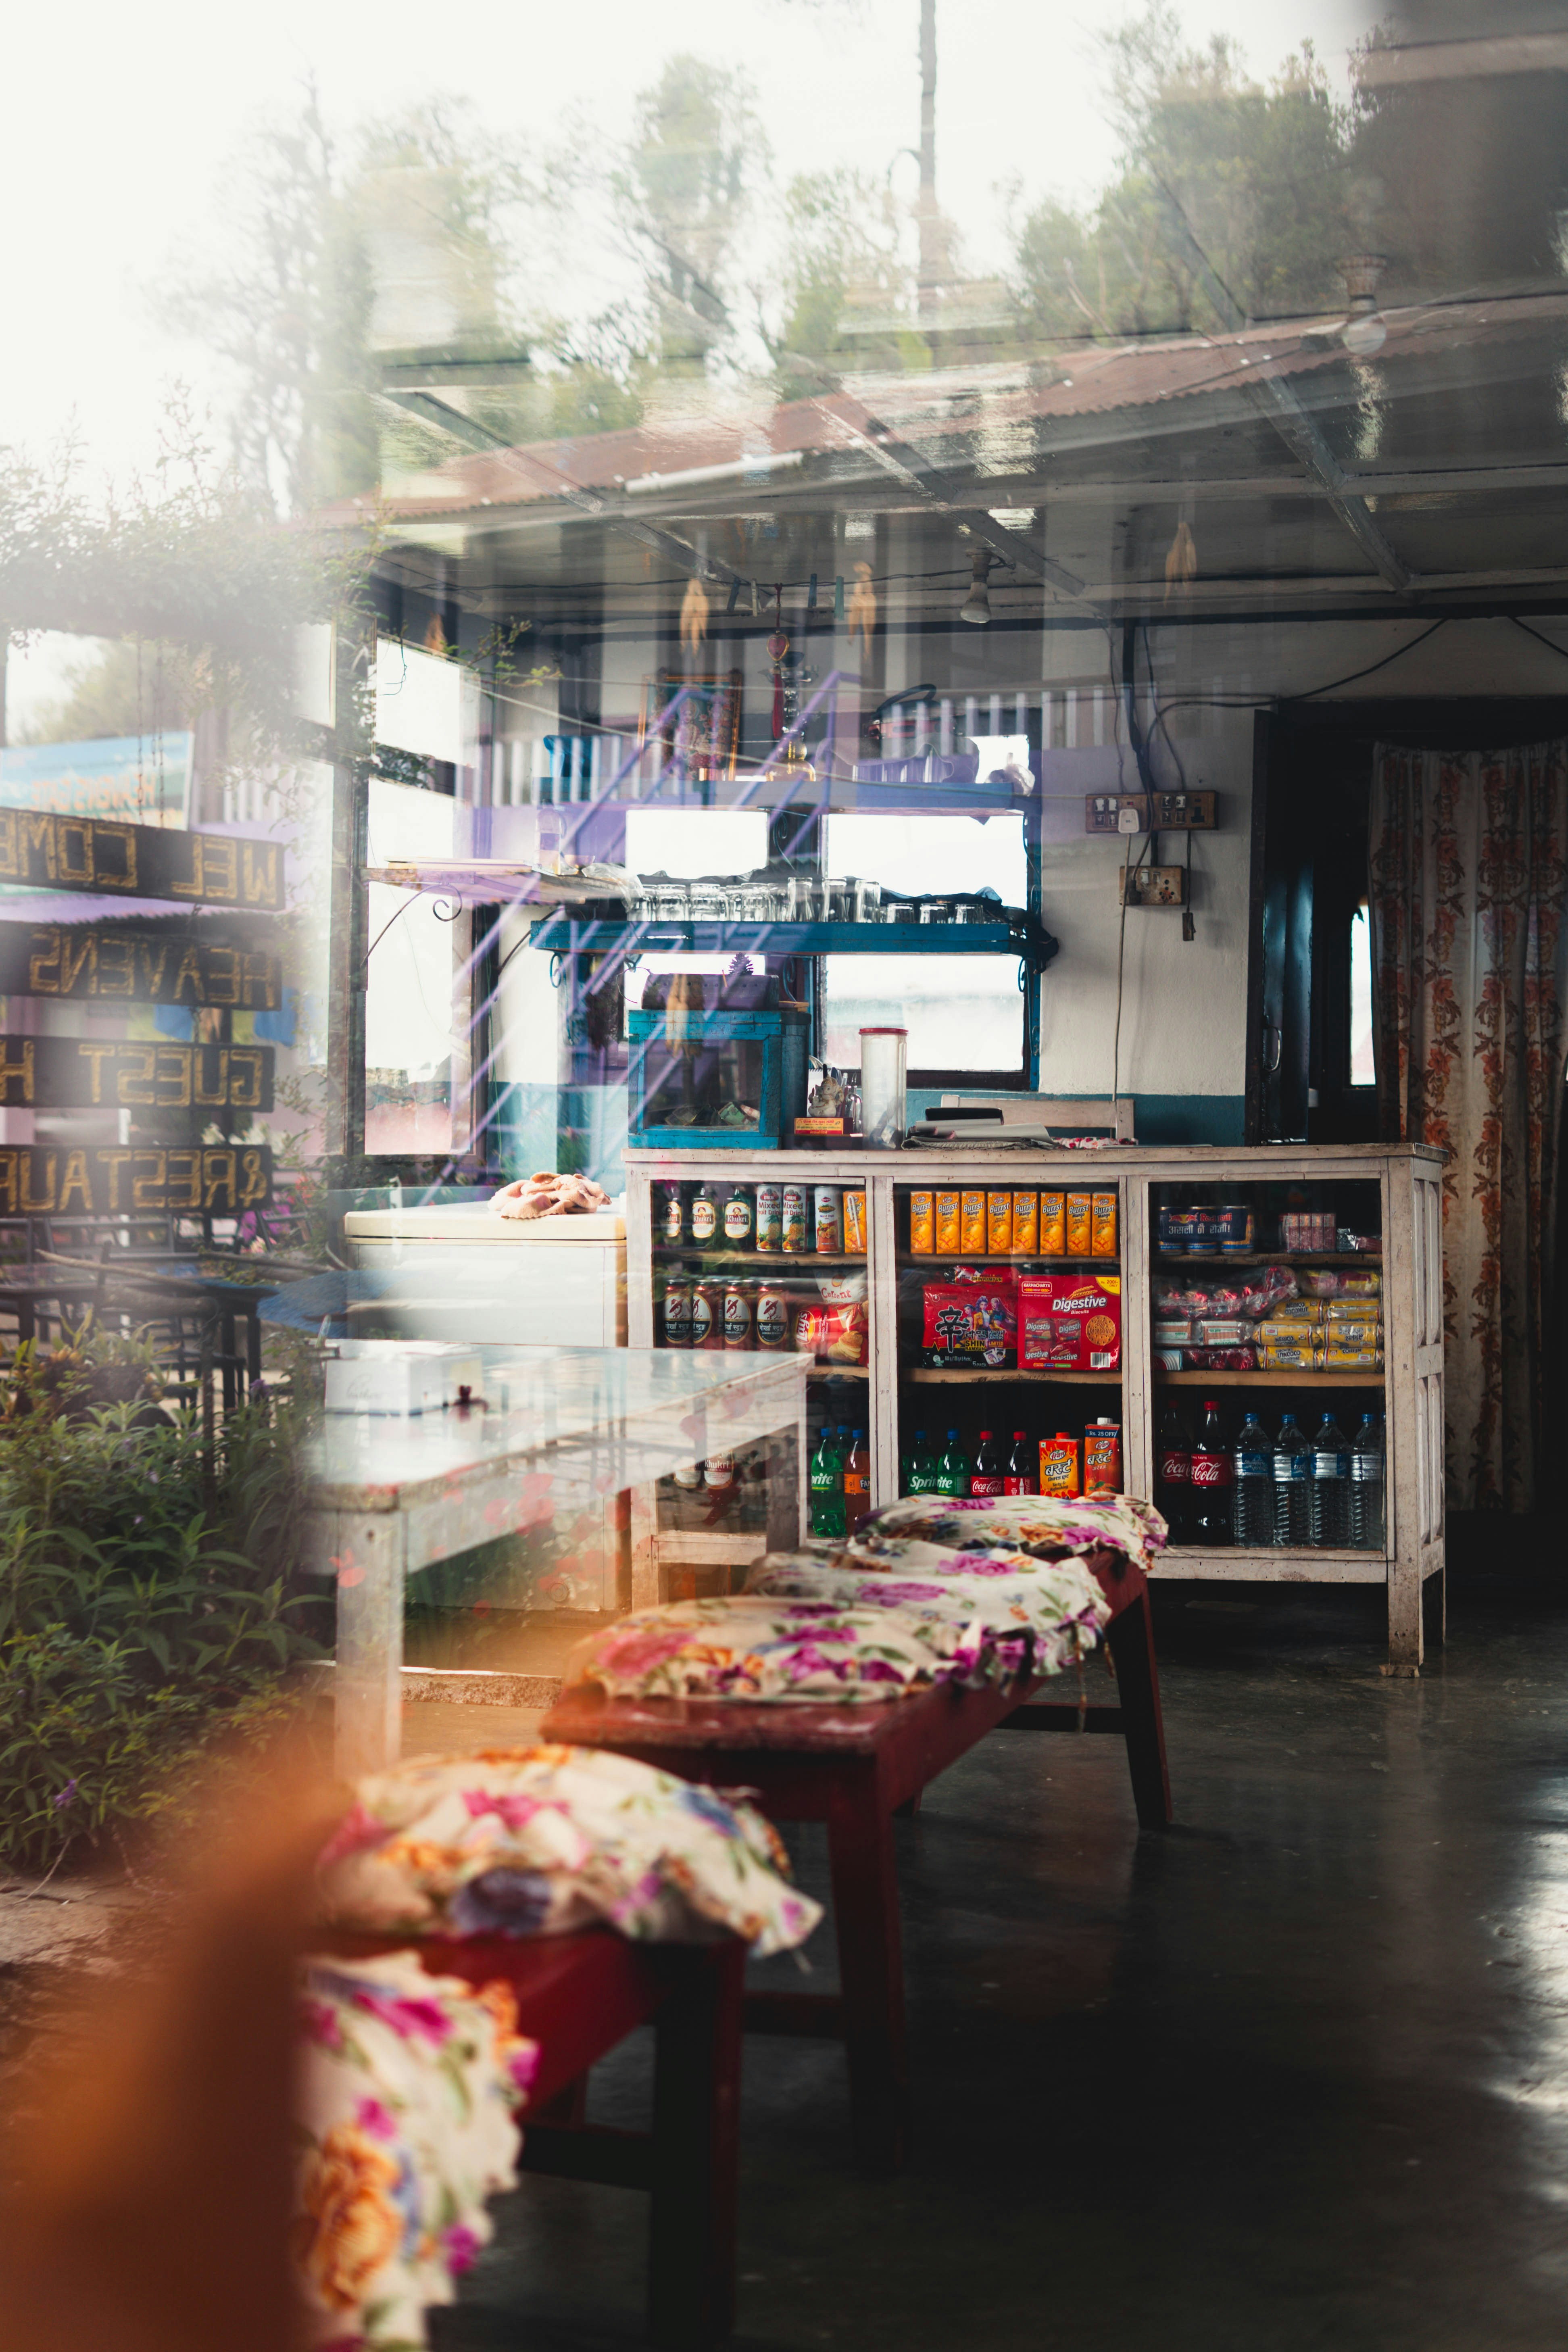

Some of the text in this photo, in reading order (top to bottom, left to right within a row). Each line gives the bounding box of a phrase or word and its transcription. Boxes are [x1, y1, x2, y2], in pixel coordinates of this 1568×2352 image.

[912, 1201, 930, 1212] Burrst
[938, 1202, 958, 1213] Burrst
[963, 1202, 983, 1212] Burrst
[990, 1202, 1009, 1213] Burrst
[1015, 1202, 1035, 1213] Burrst
[1043, 1202, 1062, 1213] Burrst
[1069, 1204, 1088, 1214] Burrst
[1094, 1204, 1114, 1215] Burrst
[822, 1287, 852, 1299] Current
[1053, 1296, 1106, 1312] Digestive
[797, 1312, 810, 1341] Lay's
[1025, 1351, 1048, 1359] igestive
[910, 1476, 936, 1490] Sprit
[938, 1476, 953, 1488] rite
[973, 1480, 1002, 1493] Coca-Cola
